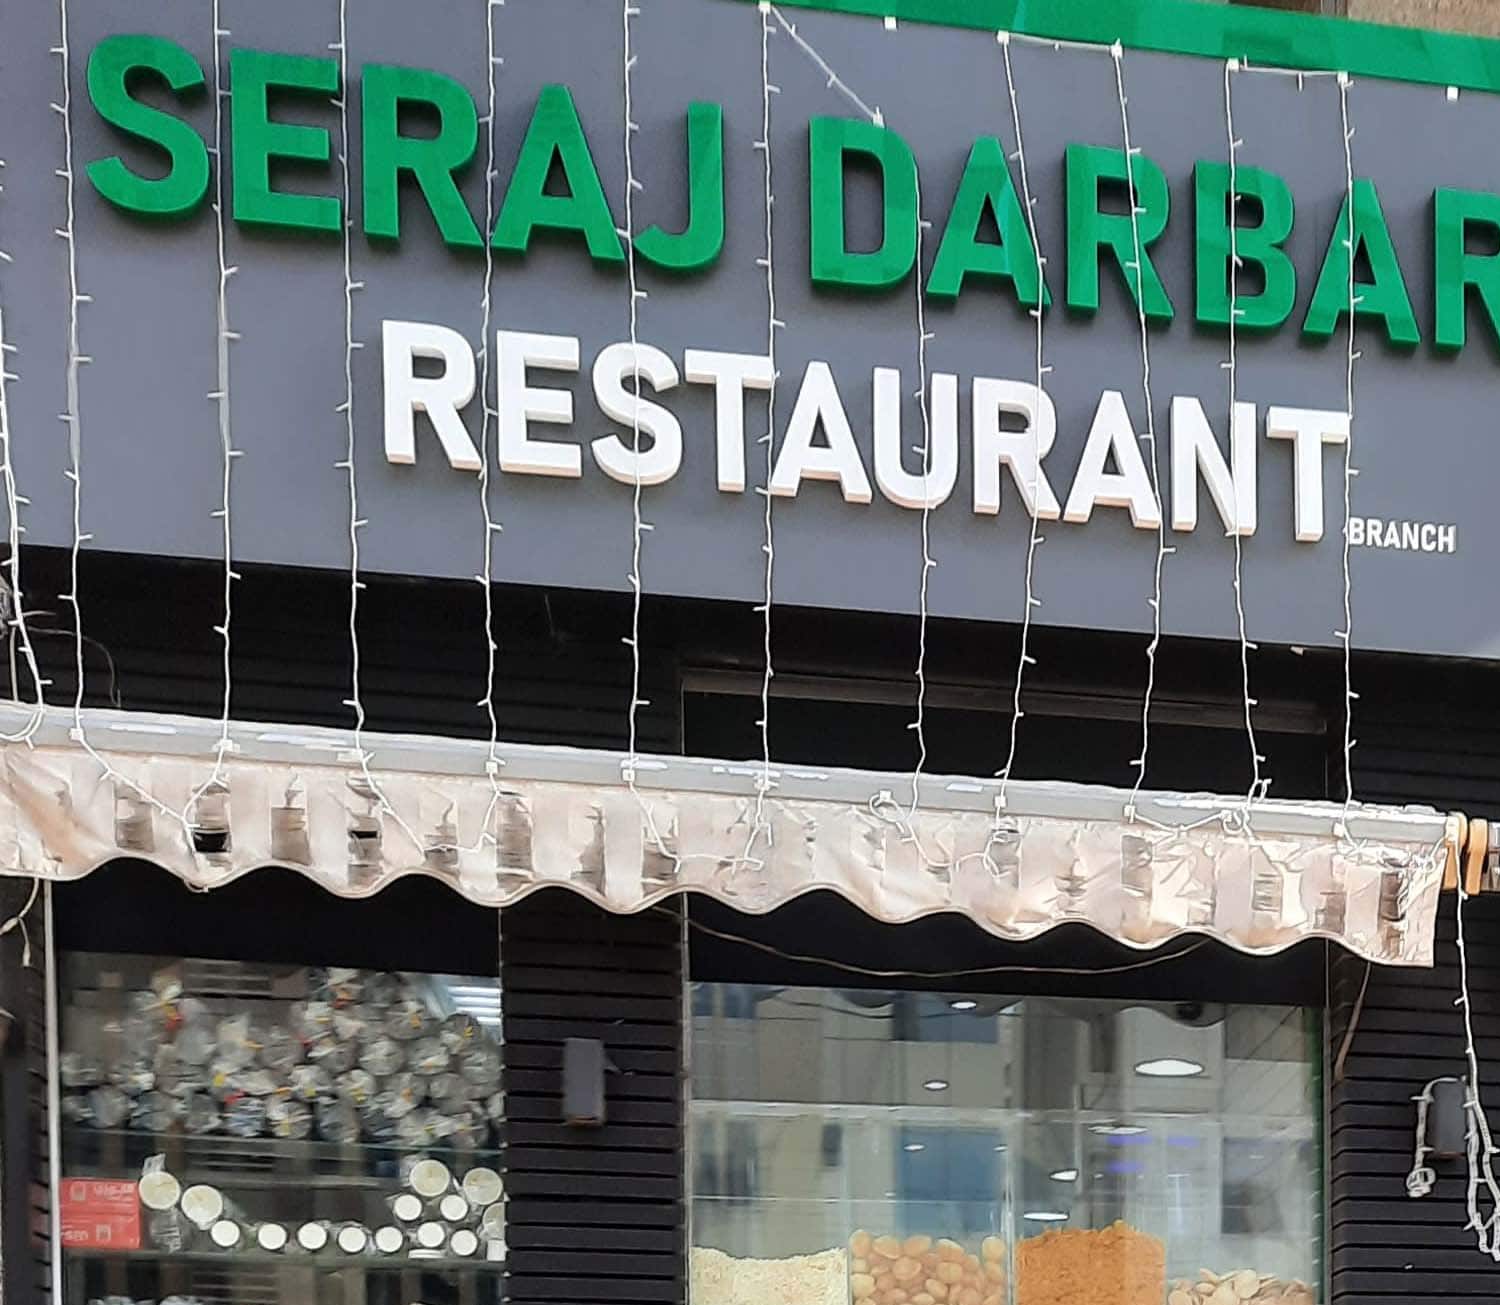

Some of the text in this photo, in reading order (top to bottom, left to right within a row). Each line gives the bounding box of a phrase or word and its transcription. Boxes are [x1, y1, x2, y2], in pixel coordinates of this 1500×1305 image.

[86, 34, 724, 270] SERAJ
[381, 320, 1350, 544] RESTAURANT
[1348, 516, 1457, 553] BRANCH
